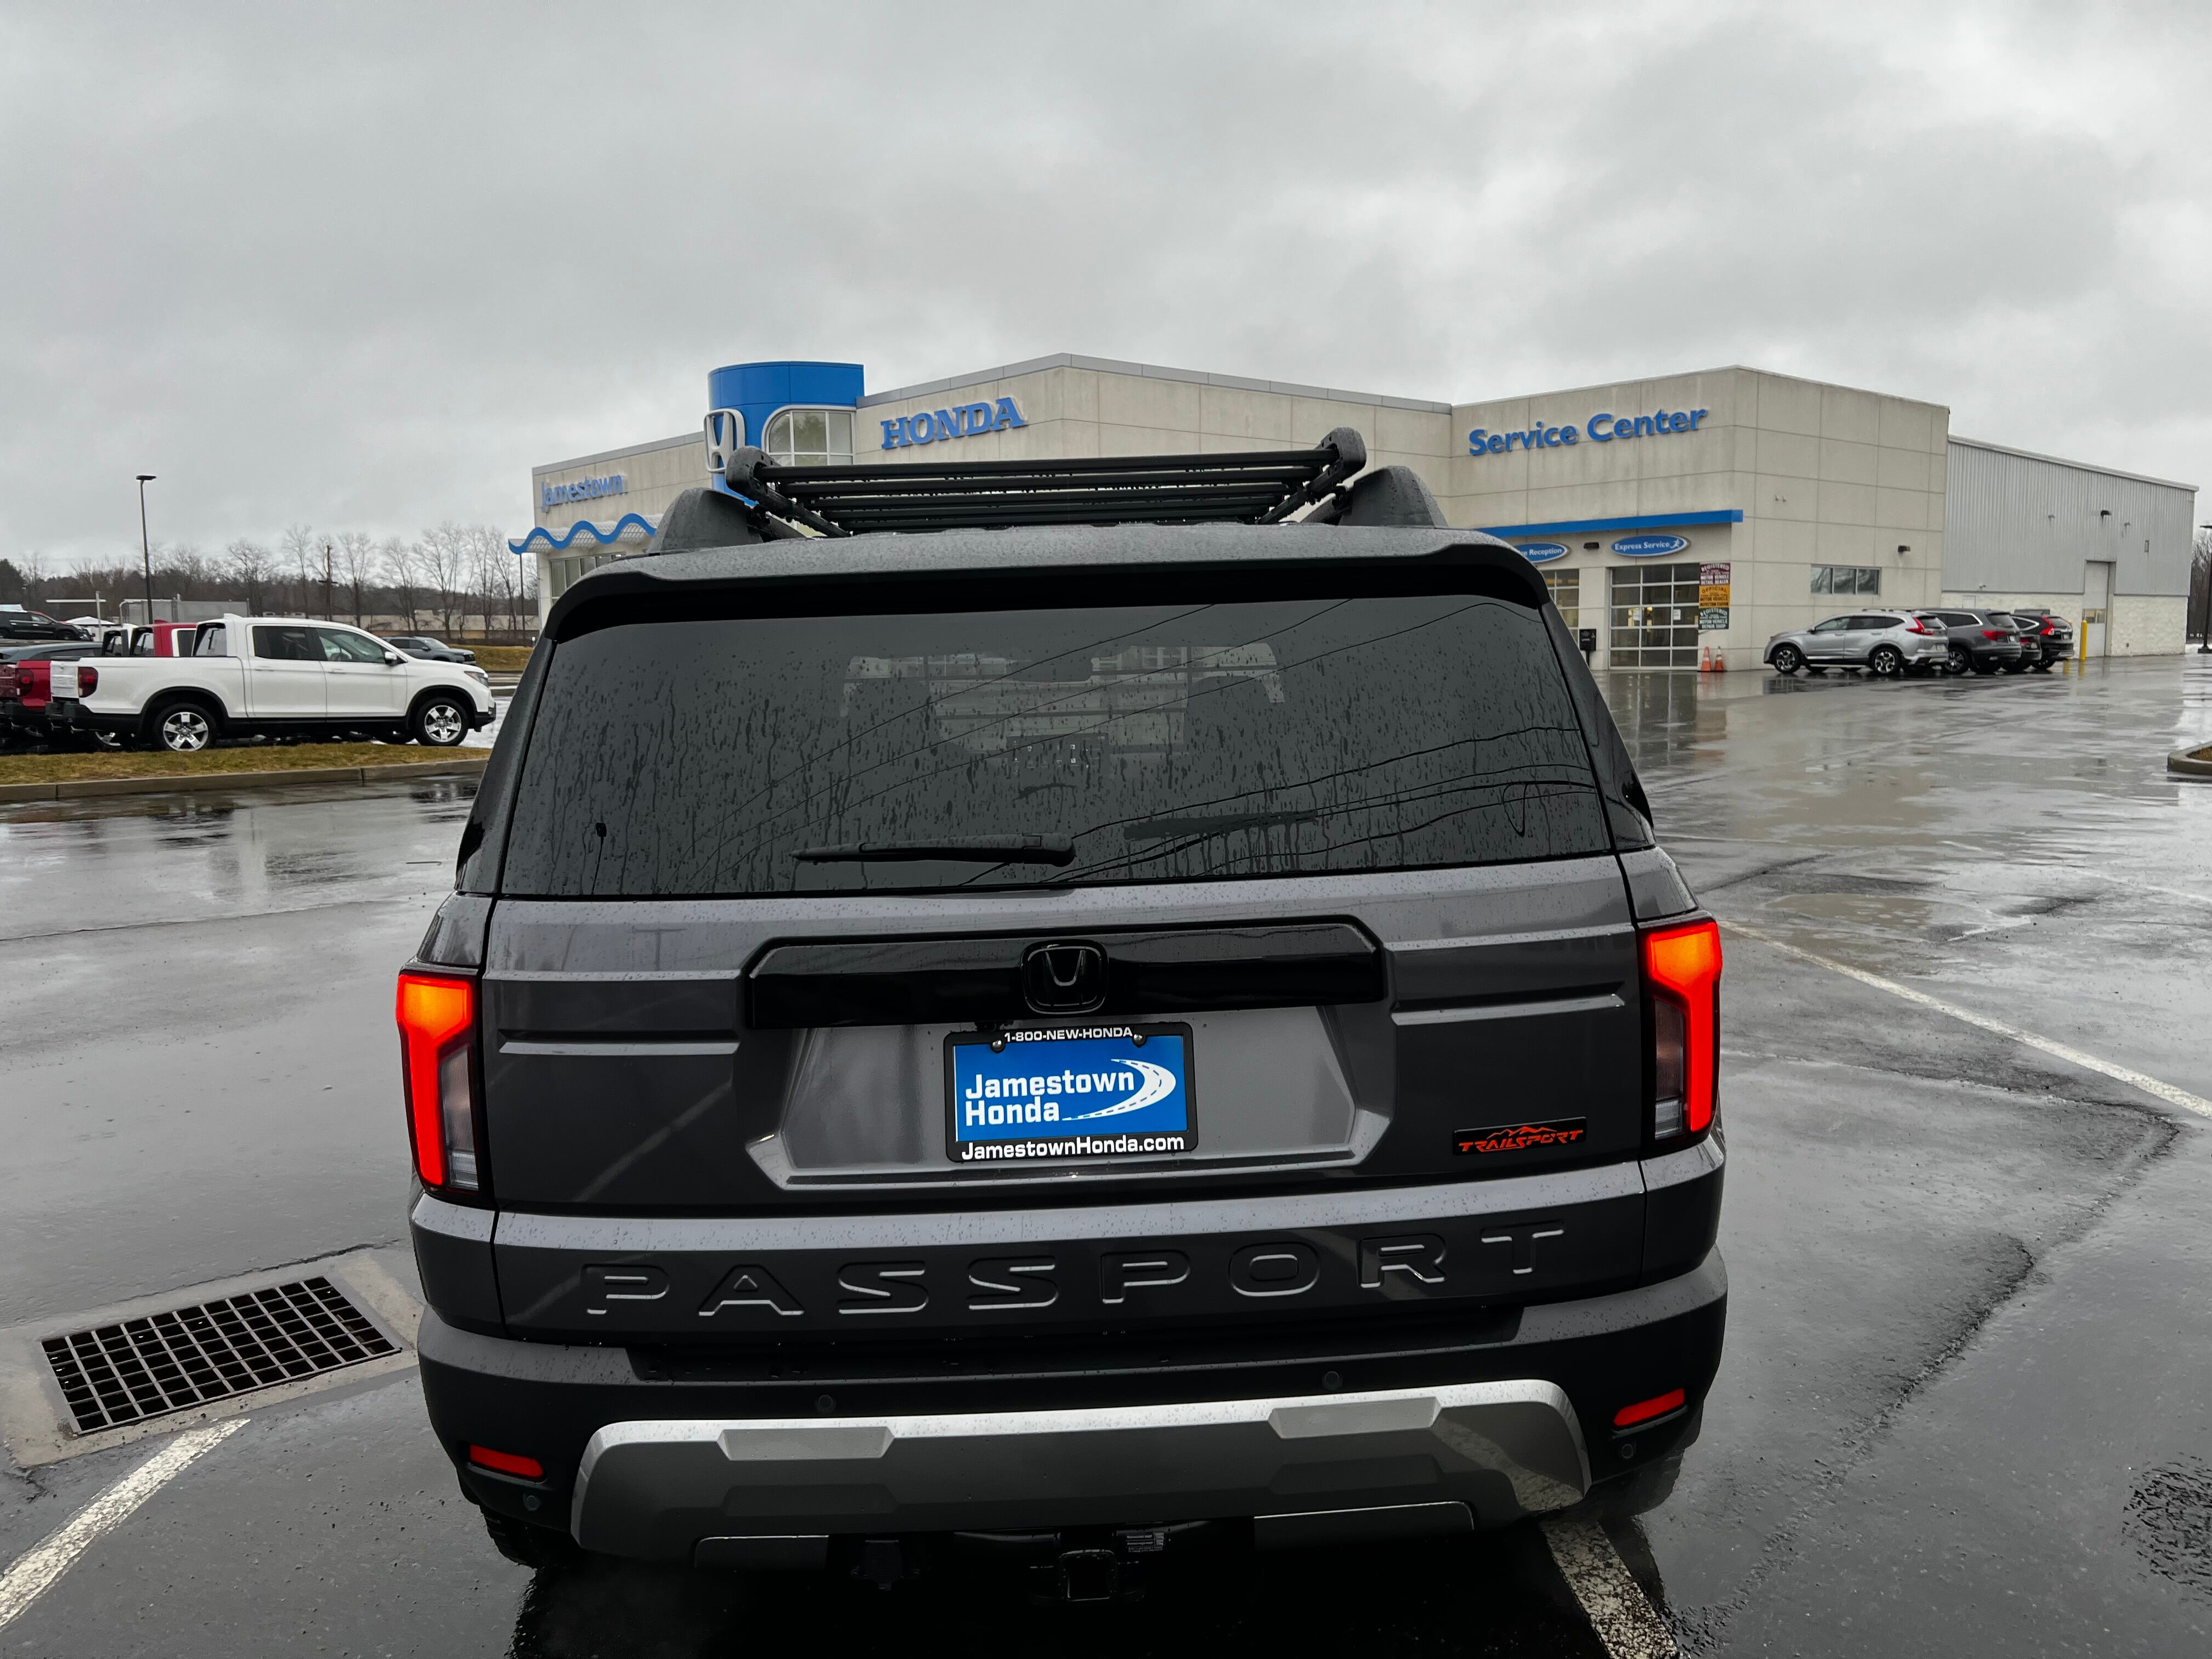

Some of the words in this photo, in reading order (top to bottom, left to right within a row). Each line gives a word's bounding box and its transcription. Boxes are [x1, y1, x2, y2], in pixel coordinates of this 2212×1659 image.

[880, 397, 1025, 450] HONDA
[1469, 421, 1578, 455] Service
[1587, 408, 1707, 441] Center
[541, 475, 623, 513] Jamestown
[1529, 548, 1562, 556] Reception
[1615, 543, 1642, 551] Express
[1004, 1027, 1133, 1042] 1-800-NEW-HONDA
[966, 1070, 1135, 1099] Jamestown
[966, 1097, 1060, 1126] Honda
[962, 1135, 1184, 1160] JamestownHonda.com
[1458, 1130, 1583, 1152] TRAILSPORT
[582, 1221, 1565, 1317] PASSPORT
